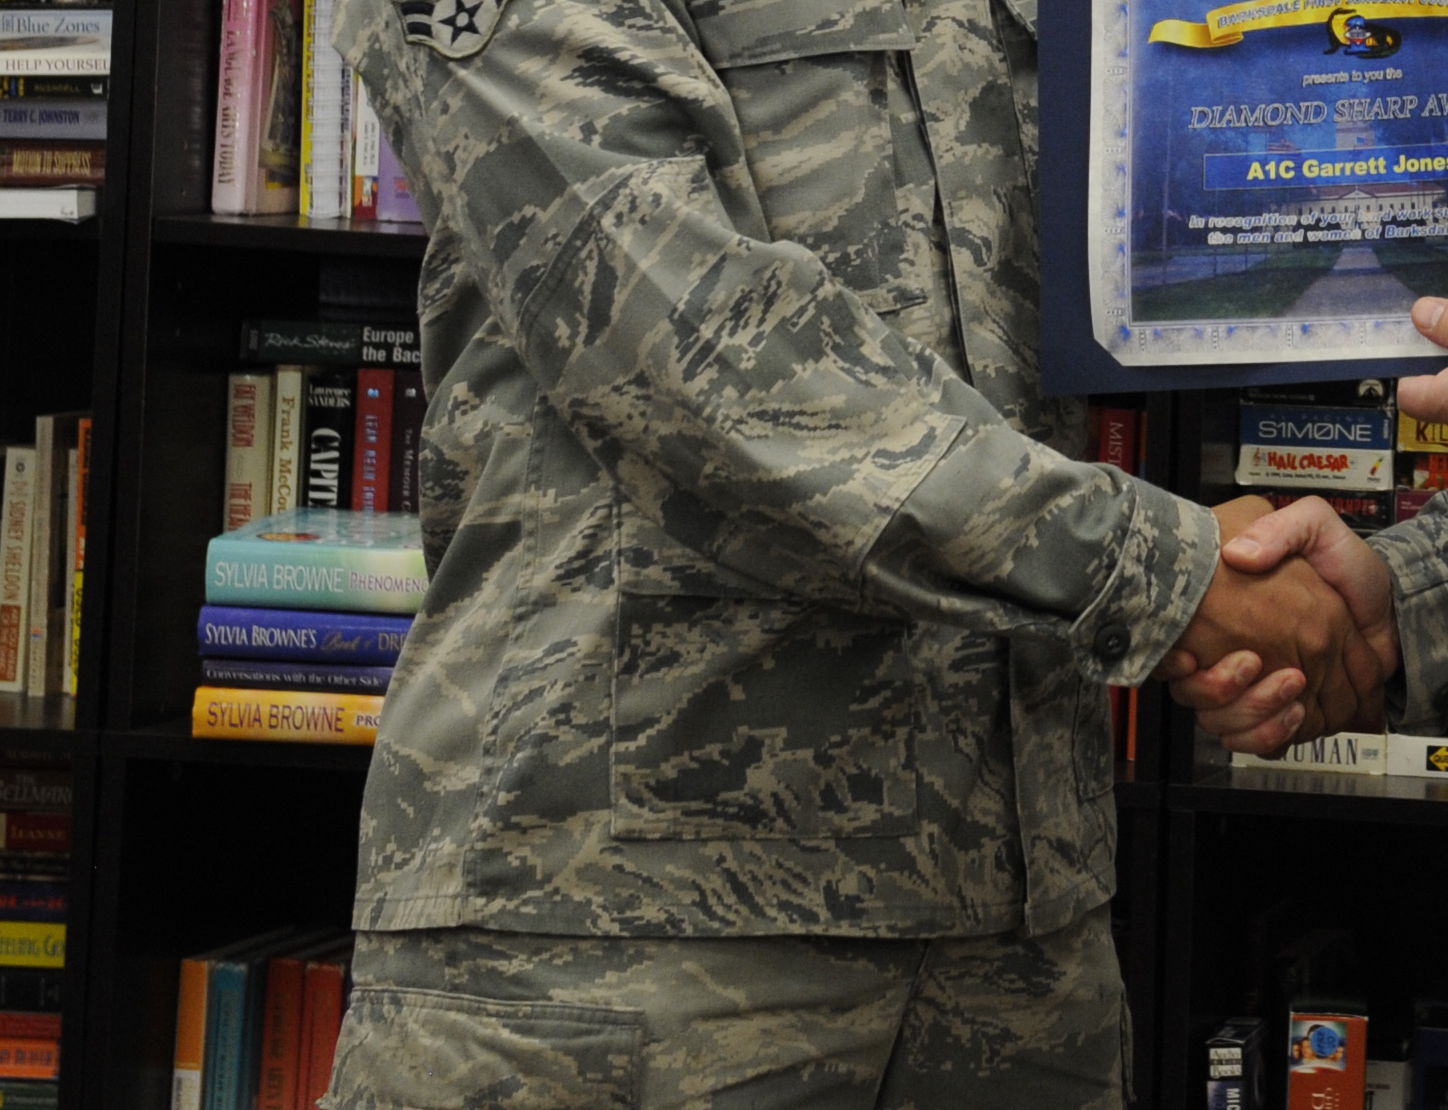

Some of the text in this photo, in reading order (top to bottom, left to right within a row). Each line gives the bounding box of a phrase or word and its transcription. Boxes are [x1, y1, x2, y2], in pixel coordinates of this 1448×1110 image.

[1218, 1, 1301, 28] BARKSDALE
[17, 17, 99, 34] Blue Zones
[5, 58, 42, 72] HELP
[1302, 67, 1402, 87] presents to you the
[1188, 100, 1327, 130] DIAMOND
[1334, 95, 1417, 123] SHARP
[1247, 160, 1295, 181] A1C
[1302, 157, 1386, 178] Garrett
[1189, 215, 1205, 229] In
[1208, 212, 1297, 229] recognition
[1301, 212, 1317, 226] of
[1320, 213, 1355, 229] your
[1395, 208, 1431, 221] work
[1208, 230, 1233, 244] the
[1236, 231, 1271, 244] men
[1274, 228, 1303, 242] and
[1307, 228, 1362, 242] women
[1364, 226, 1381, 239] of
[363, 327, 414, 347] Europe
[362, 346, 386, 362] the
[280, 396, 297, 451] Frank
[1267, 451, 1350, 472] HAIL CAESAR
[215, 561, 269, 588] SYLVIA
[273, 564, 344, 593] BROWNE
[205, 622, 317, 650] SYLVIA BROWNE'S
[207, 667, 384, 688] Conversations with the Other Side
[208, 702, 345, 732] SYLVIA BROWNE
